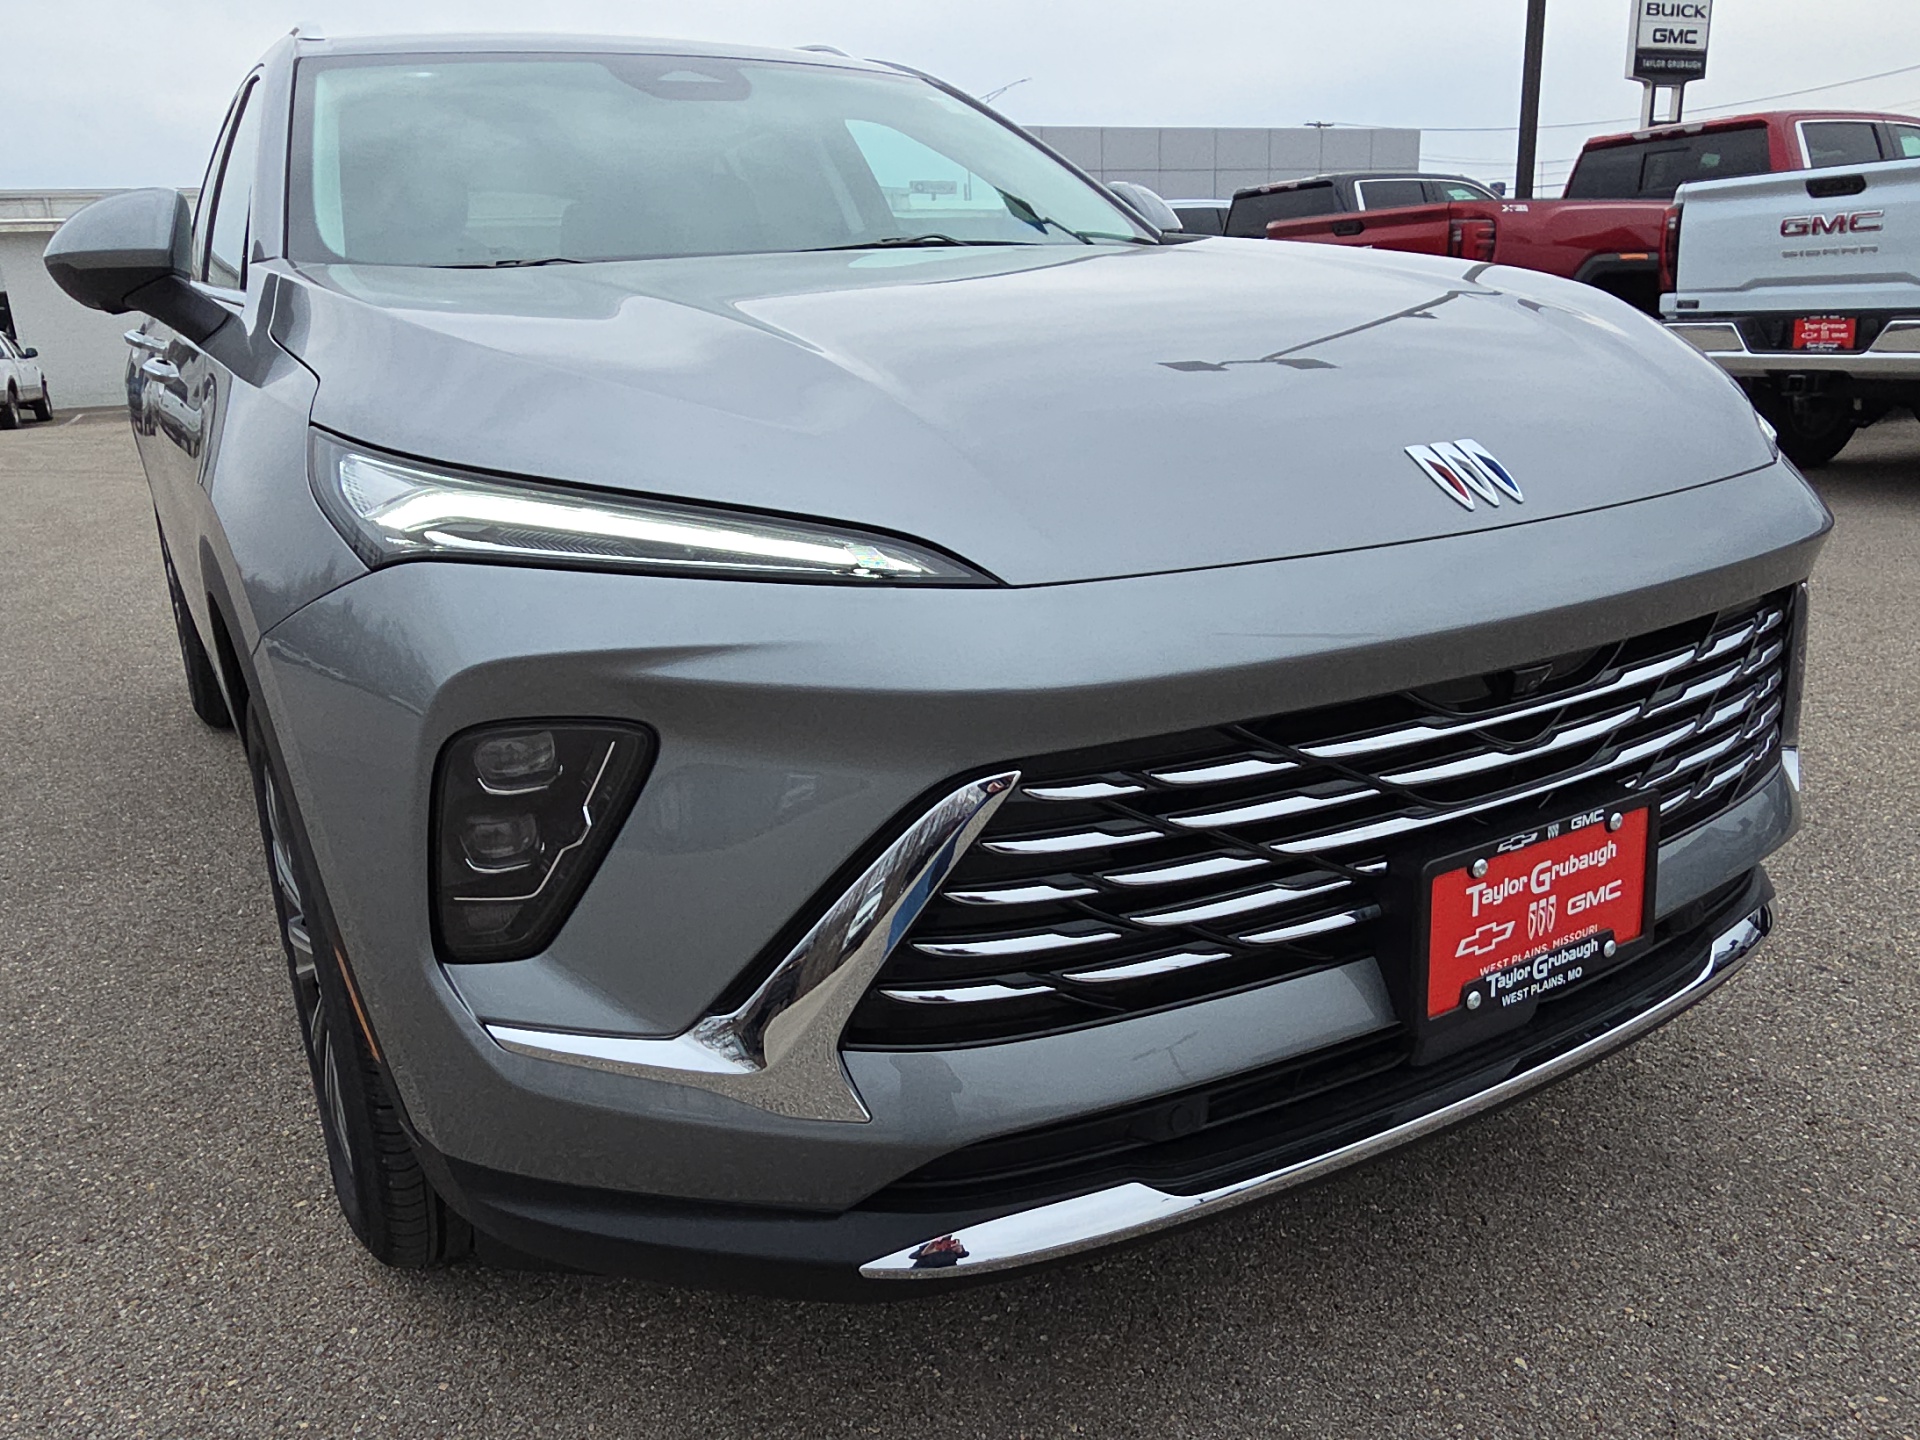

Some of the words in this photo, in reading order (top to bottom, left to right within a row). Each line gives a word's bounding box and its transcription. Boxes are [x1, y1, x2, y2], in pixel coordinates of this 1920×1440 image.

[1645, 2, 1707, 19] BUICK
[1652, 28, 1698, 45] GMC
[1780, 209, 1884, 238] GMC
[1570, 809, 1605, 830] GMC
[1465, 876, 1528, 918] Taylor
[1530, 840, 1617, 895] Grubaugh
[1566, 879, 1622, 916] GMC
[1479, 957, 1510, 977] WEST
[1552, 923, 1599, 949] MISSOURI
[1485, 965, 1531, 998] Taylor
[1532, 938, 1599, 980] Grubaugh
[1501, 986, 1530, 1008] WEST
[1530, 973, 1566, 996] PLAINS,
[1567, 966, 1583, 982] MO
